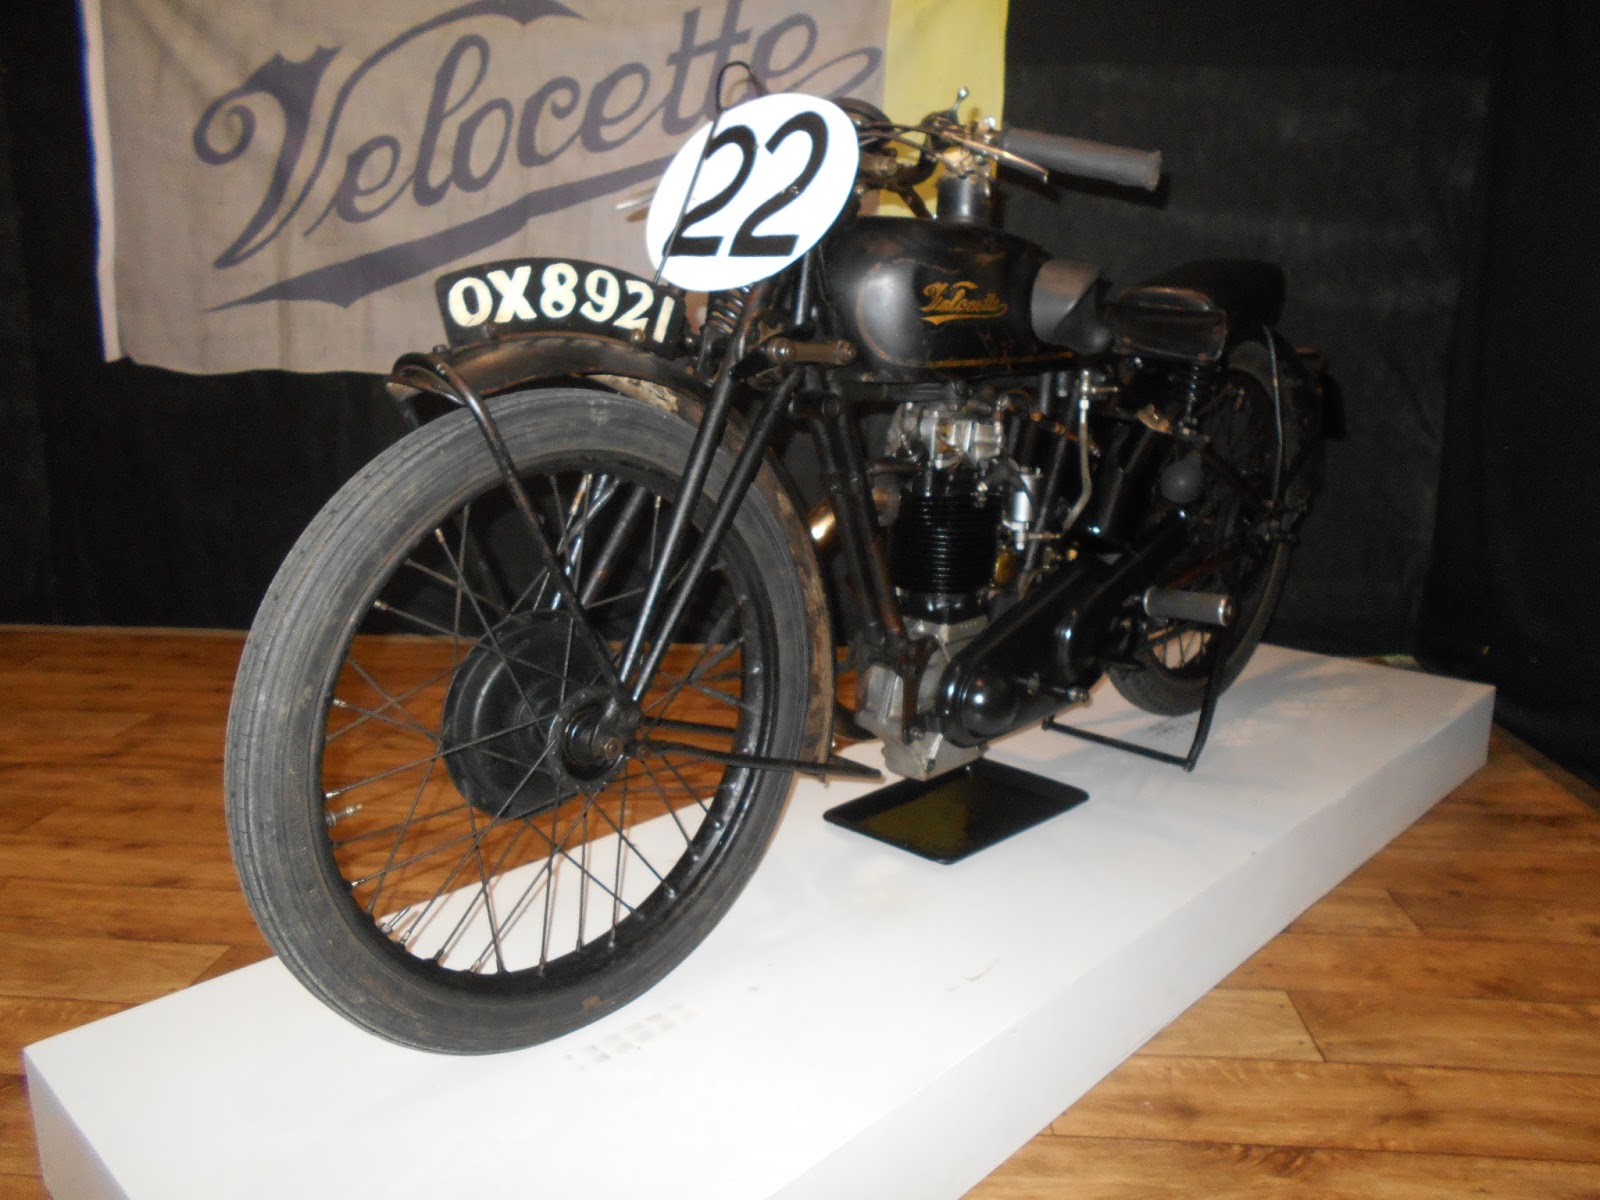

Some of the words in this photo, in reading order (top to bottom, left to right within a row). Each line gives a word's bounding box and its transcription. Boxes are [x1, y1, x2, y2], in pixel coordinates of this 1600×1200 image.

[193, 0, 881, 269] Velocette
[662, 111, 829, 257] 22
[448, 262, 675, 343] OX8921
